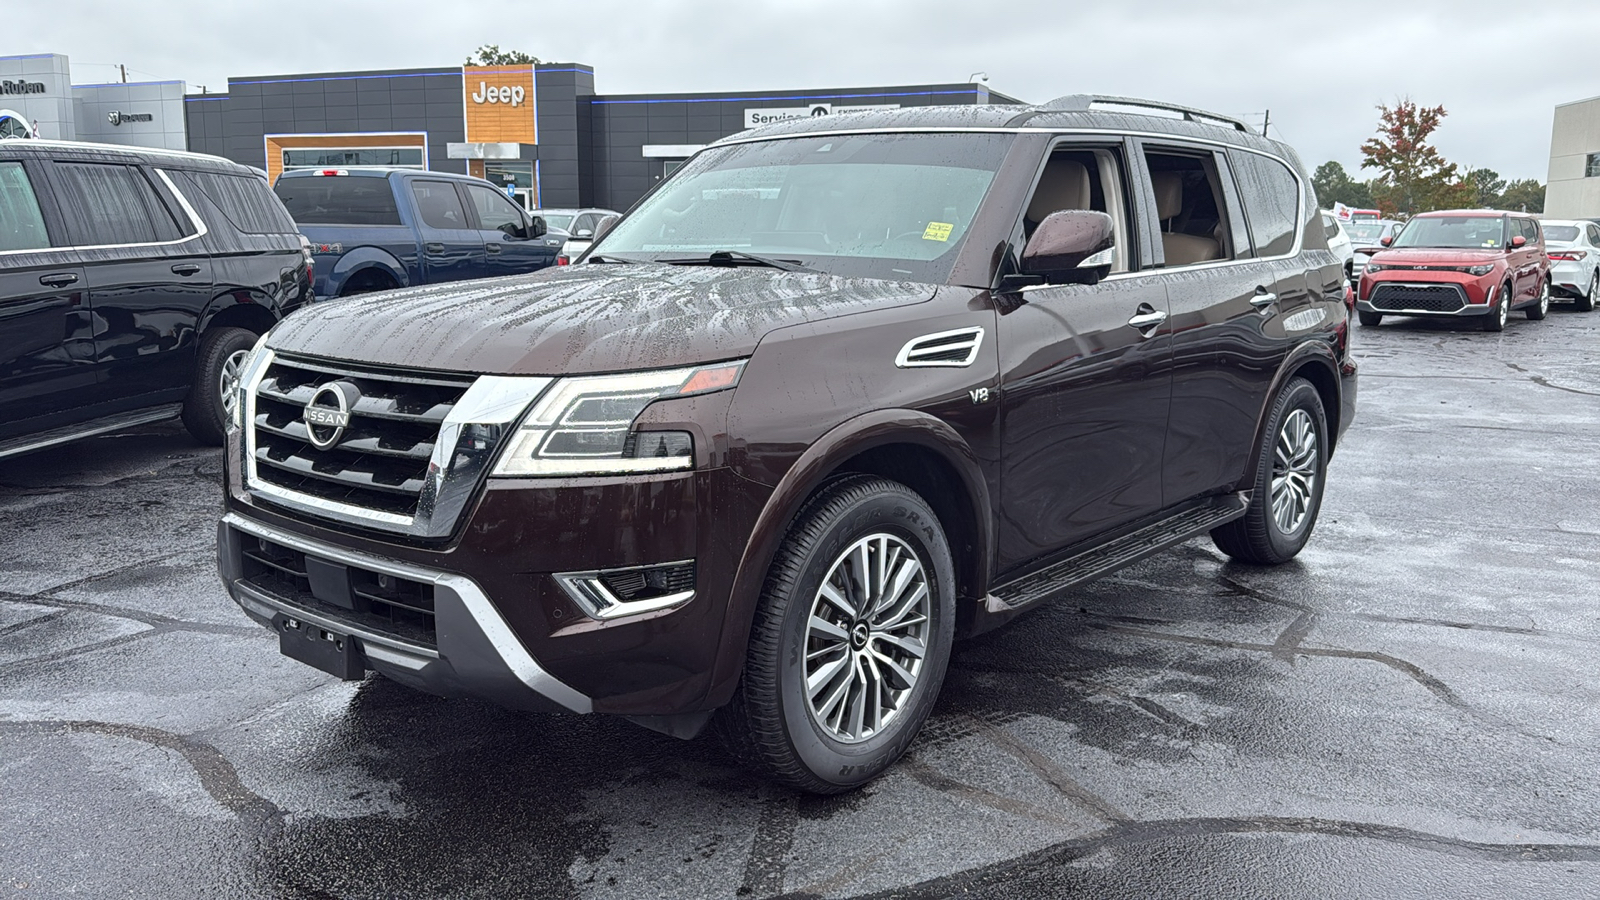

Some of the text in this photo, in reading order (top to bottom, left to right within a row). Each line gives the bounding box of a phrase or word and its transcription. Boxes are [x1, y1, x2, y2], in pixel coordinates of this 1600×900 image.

[3, 80, 45, 94] Ruben
[472, 81, 524, 106] Jeep
[969, 387, 989, 403] V8
[304, 408, 347, 425] NISSAN
